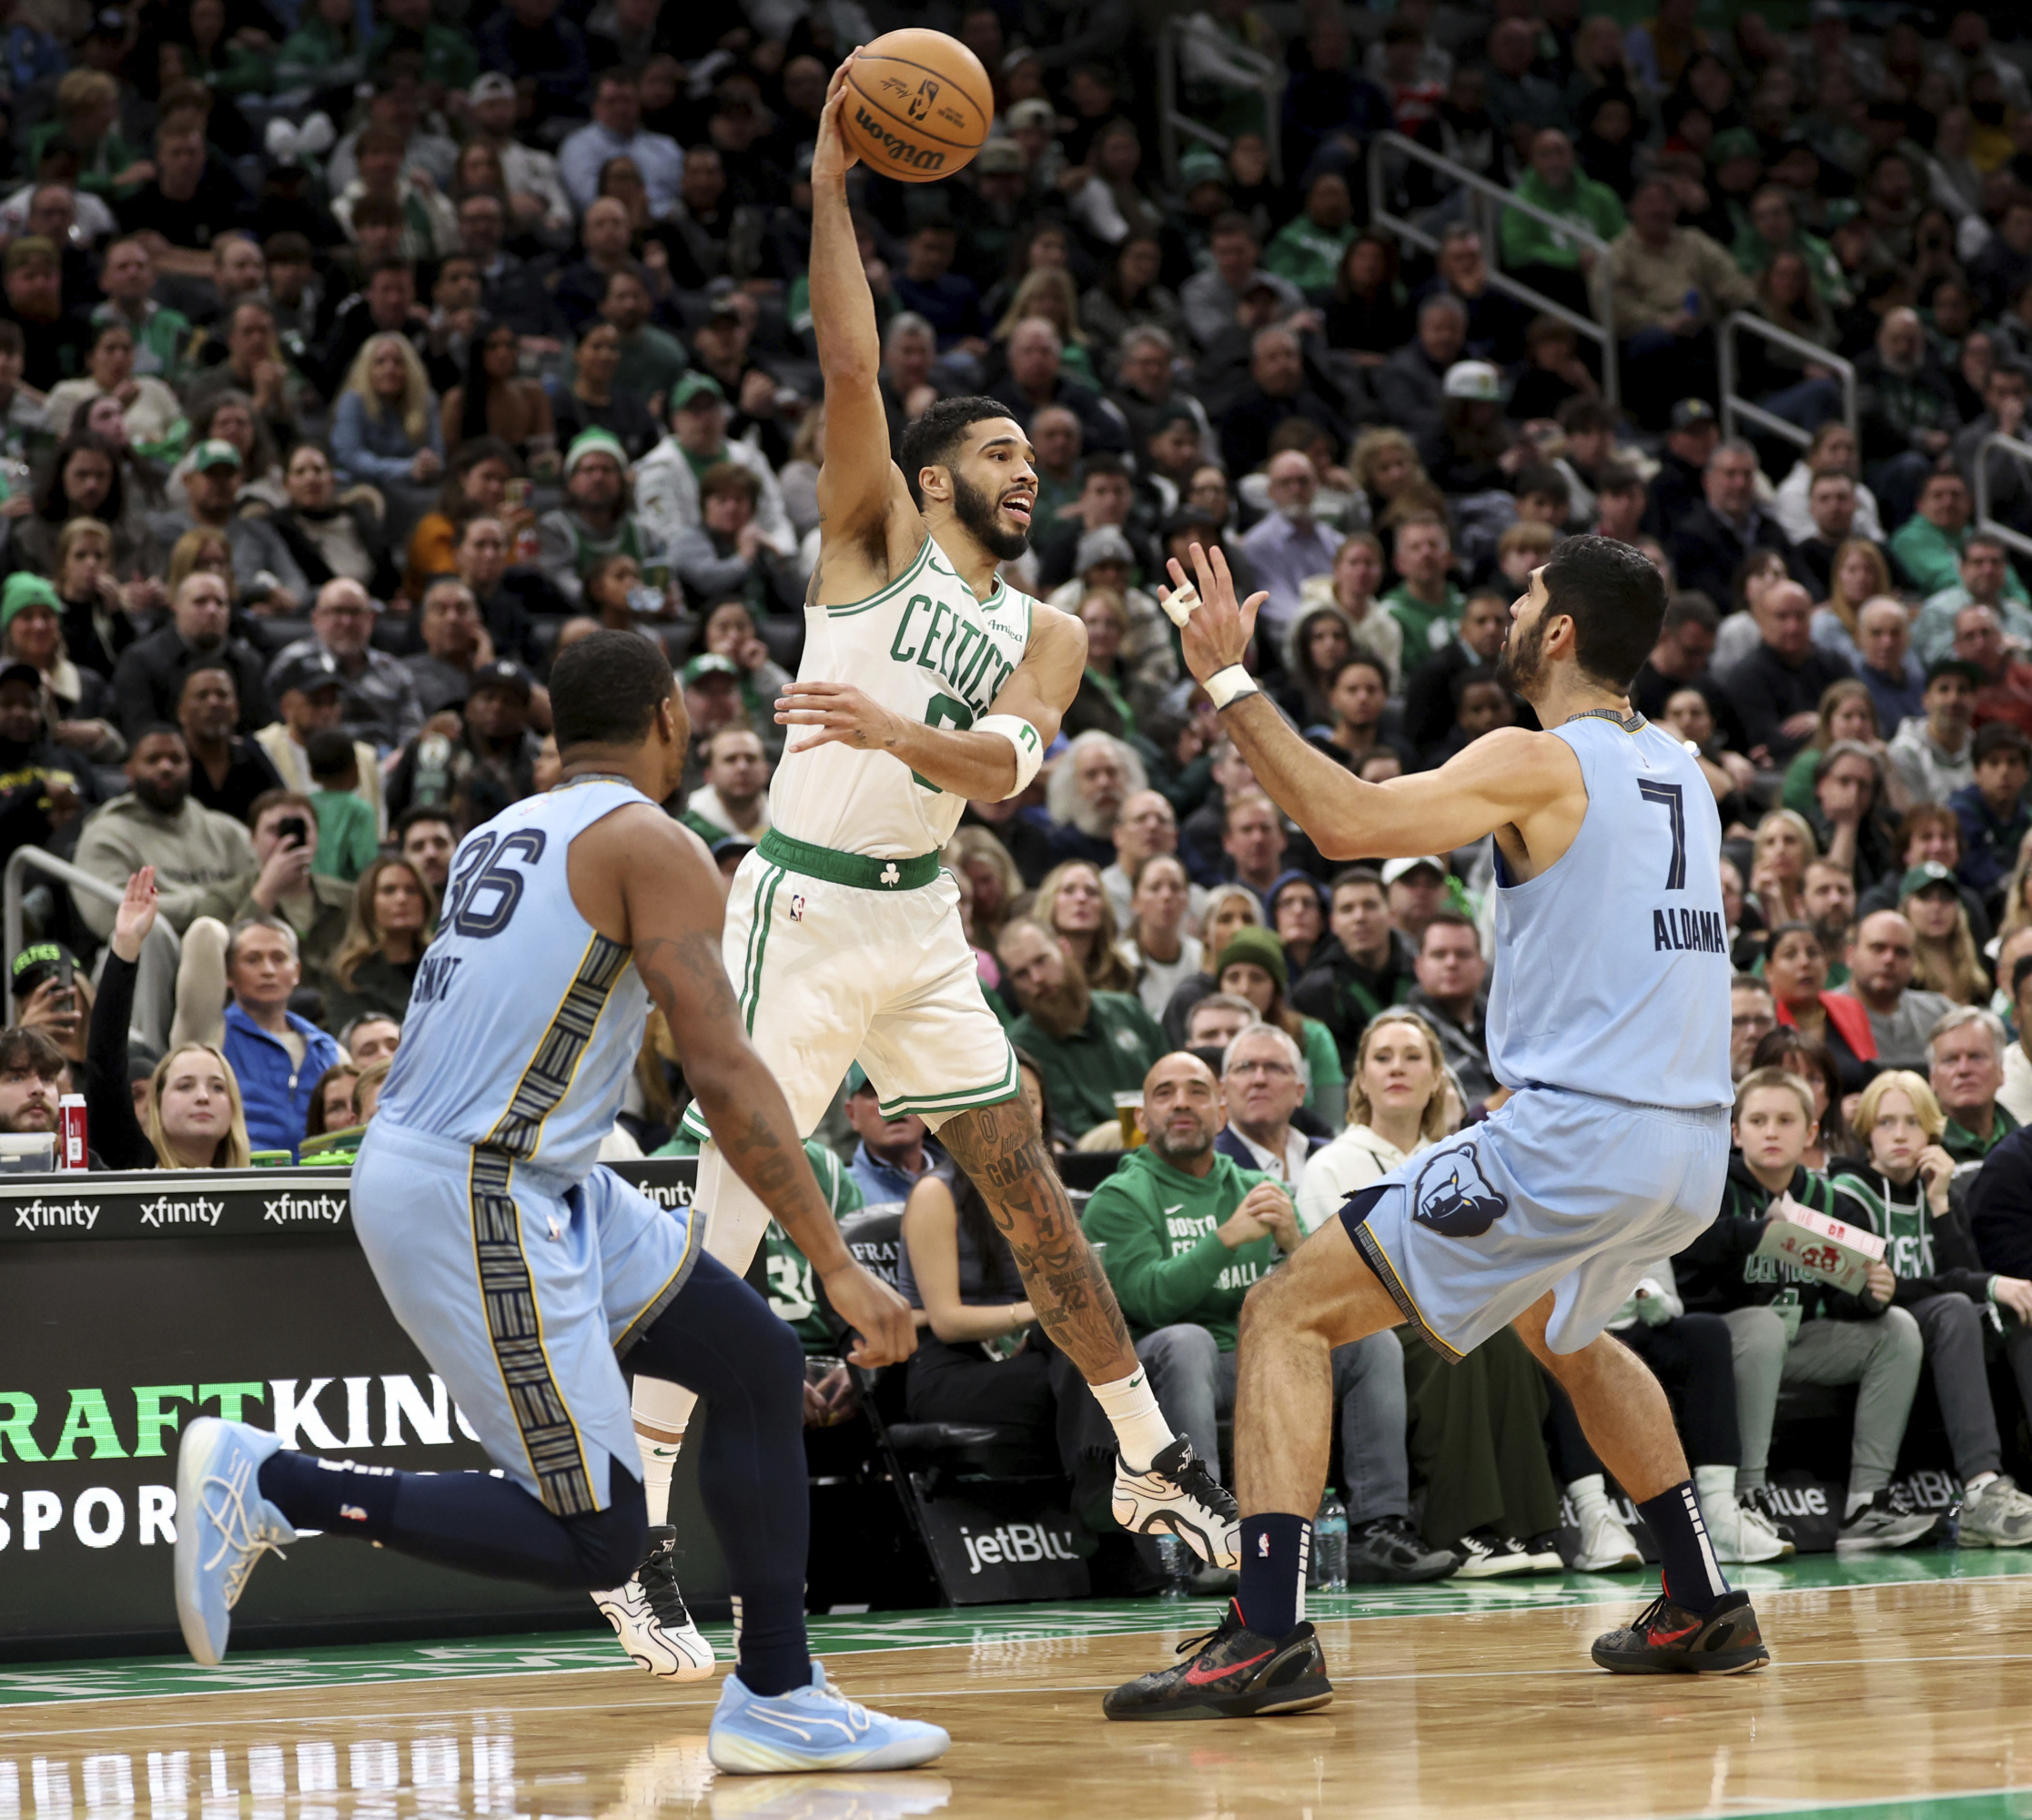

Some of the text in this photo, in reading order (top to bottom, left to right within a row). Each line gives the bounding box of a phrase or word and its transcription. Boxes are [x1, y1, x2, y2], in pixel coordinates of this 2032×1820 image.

[855, 106, 945, 170] Wilson
[987, 619, 1023, 642] Amica
[1636, 778, 1686, 890] 7
[433, 828, 547, 939] 36
[1653, 908, 1725, 954] ALDAMA
[263, 1192, 347, 1225] xfinity
[638, 1180, 697, 1208] finity
[15, 1198, 101, 1231] xfinity
[140, 1195, 226, 1228] xfinity
[849, 1241, 900, 1261] FRA
[1213, 1261, 1259, 1290] BALL
[0, 1374, 482, 1462] RAFTKIN
[959, 1522, 1080, 1575] jetBlu
